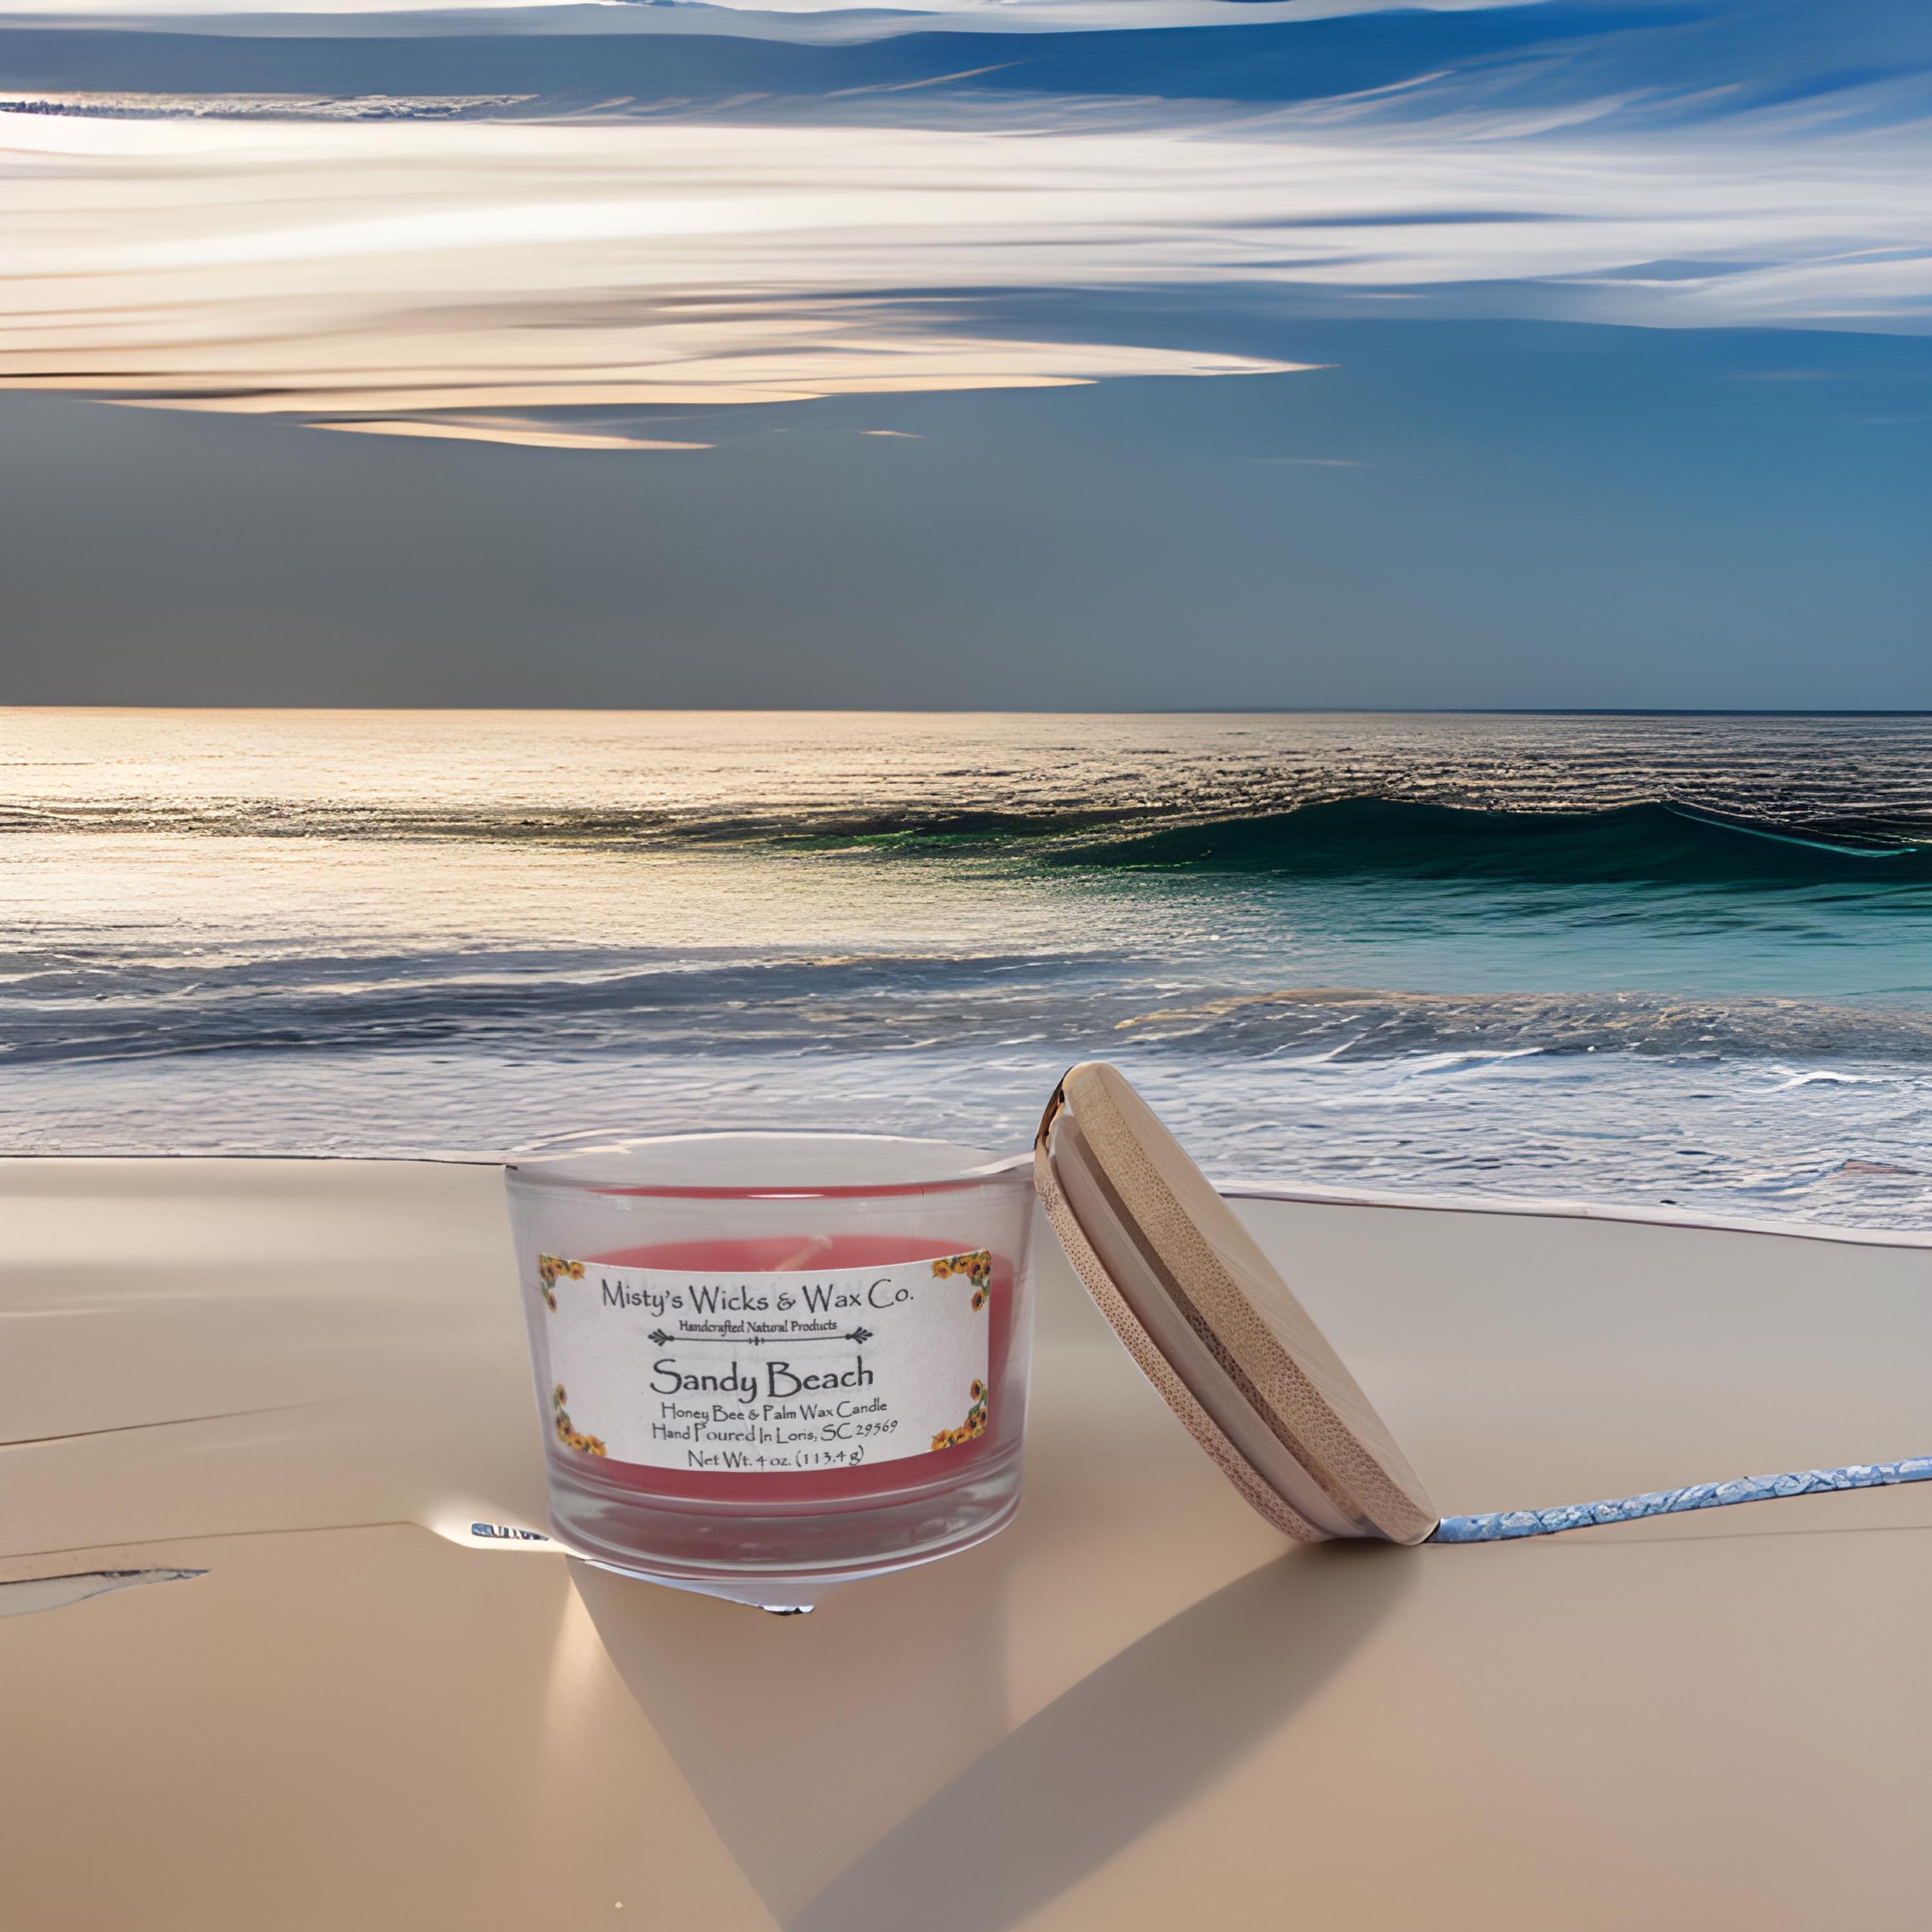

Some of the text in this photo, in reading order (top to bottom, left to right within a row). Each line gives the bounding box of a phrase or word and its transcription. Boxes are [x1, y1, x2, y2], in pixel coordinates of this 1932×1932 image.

[601, 1278, 914, 1318] Misty's Wicks & Wax Co.
[679, 1318, 838, 1338] Handcrafted Natural Products
[649, 1354, 874, 1405] Sandy Beach
[661, 1397, 887, 1424] Honey Bee & Palm Wax Candle
[652, 1419, 898, 1444] Hand Poured In Loris, SC 29569
[687, 1450, 719, 1467] Net
[722, 1451, 753, 1468] Wt.
[755, 1455, 767, 1467] 4
[770, 1457, 791, 1466] oz.
